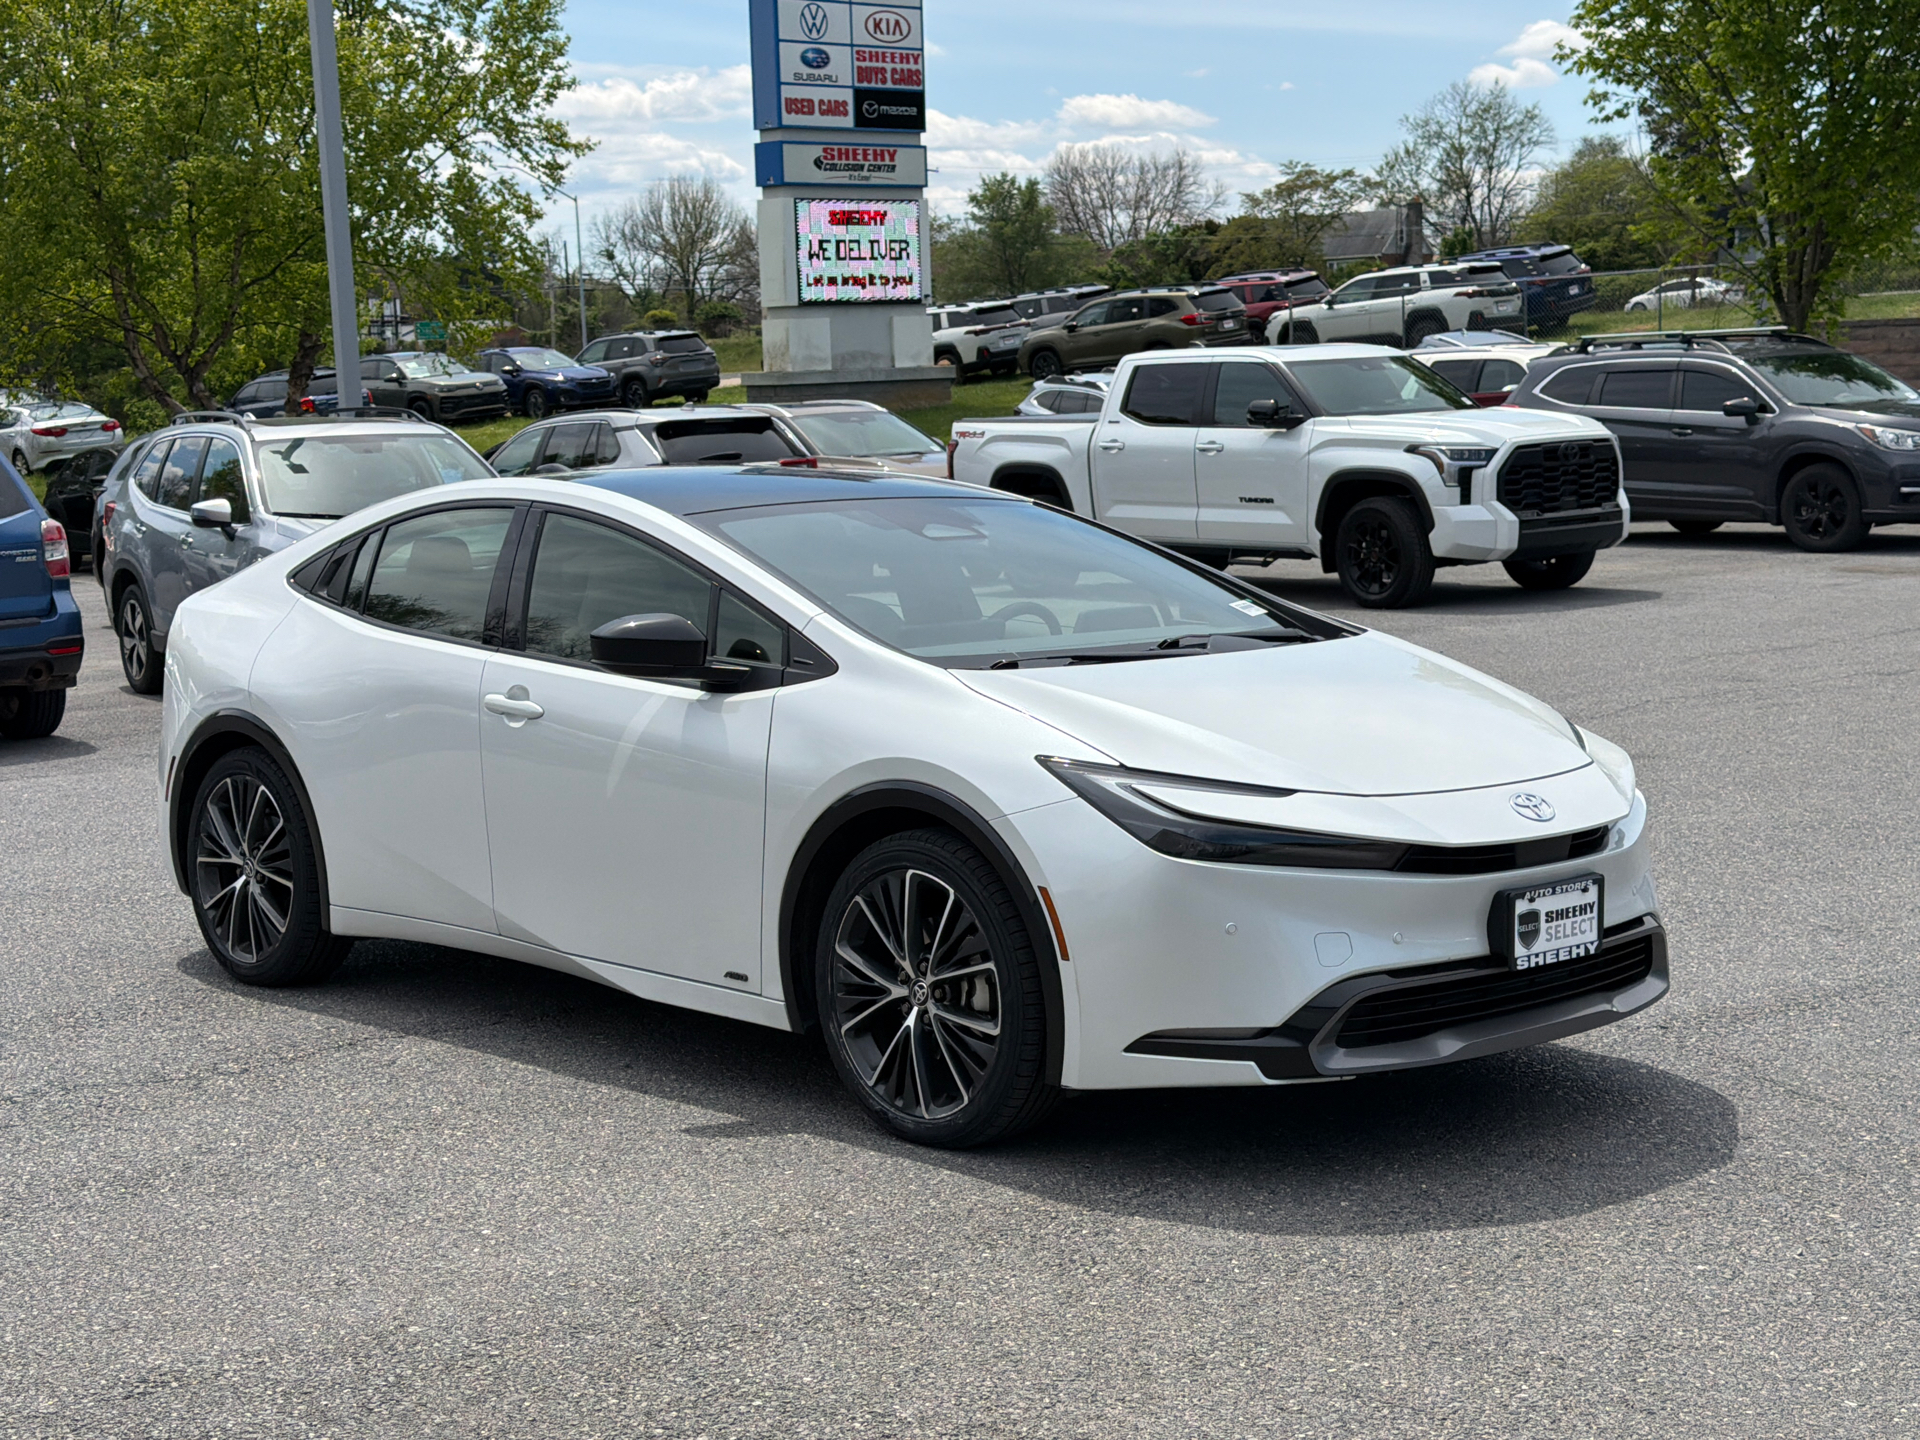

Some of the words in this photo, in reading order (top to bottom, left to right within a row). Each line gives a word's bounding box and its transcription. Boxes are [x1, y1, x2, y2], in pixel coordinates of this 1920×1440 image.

[873, 17, 904, 37] KIA
[855, 49, 921, 65] SHEEHY
[793, 72, 838, 83] SUBARU
[856, 65, 887, 85] BUYS
[890, 68, 922, 87] CARS
[784, 97, 815, 116] USED
[818, 98, 849, 117] CARS
[880, 105, 918, 116] mazda
[822, 147, 898, 163] SHEEHY
[823, 162, 865, 172] COLLISION
[867, 163, 897, 173] CENTER
[828, 210, 888, 226] SHEEHY
[808, 239, 832, 261] WE
[835, 239, 910, 261] DELIVER
[806, 273, 824, 287] Let
[878, 274, 890, 286] to
[1238, 496, 1275, 504] TUNDRA
[1524, 887, 1553, 900] AUTO
[1555, 880, 1593, 895] STORES
[1519, 922, 1539, 933] SELECT
[1544, 901, 1596, 924] SHEEHY
[1545, 916, 1596, 942] SELECT
[1516, 941, 1599, 970] SHEEHY
